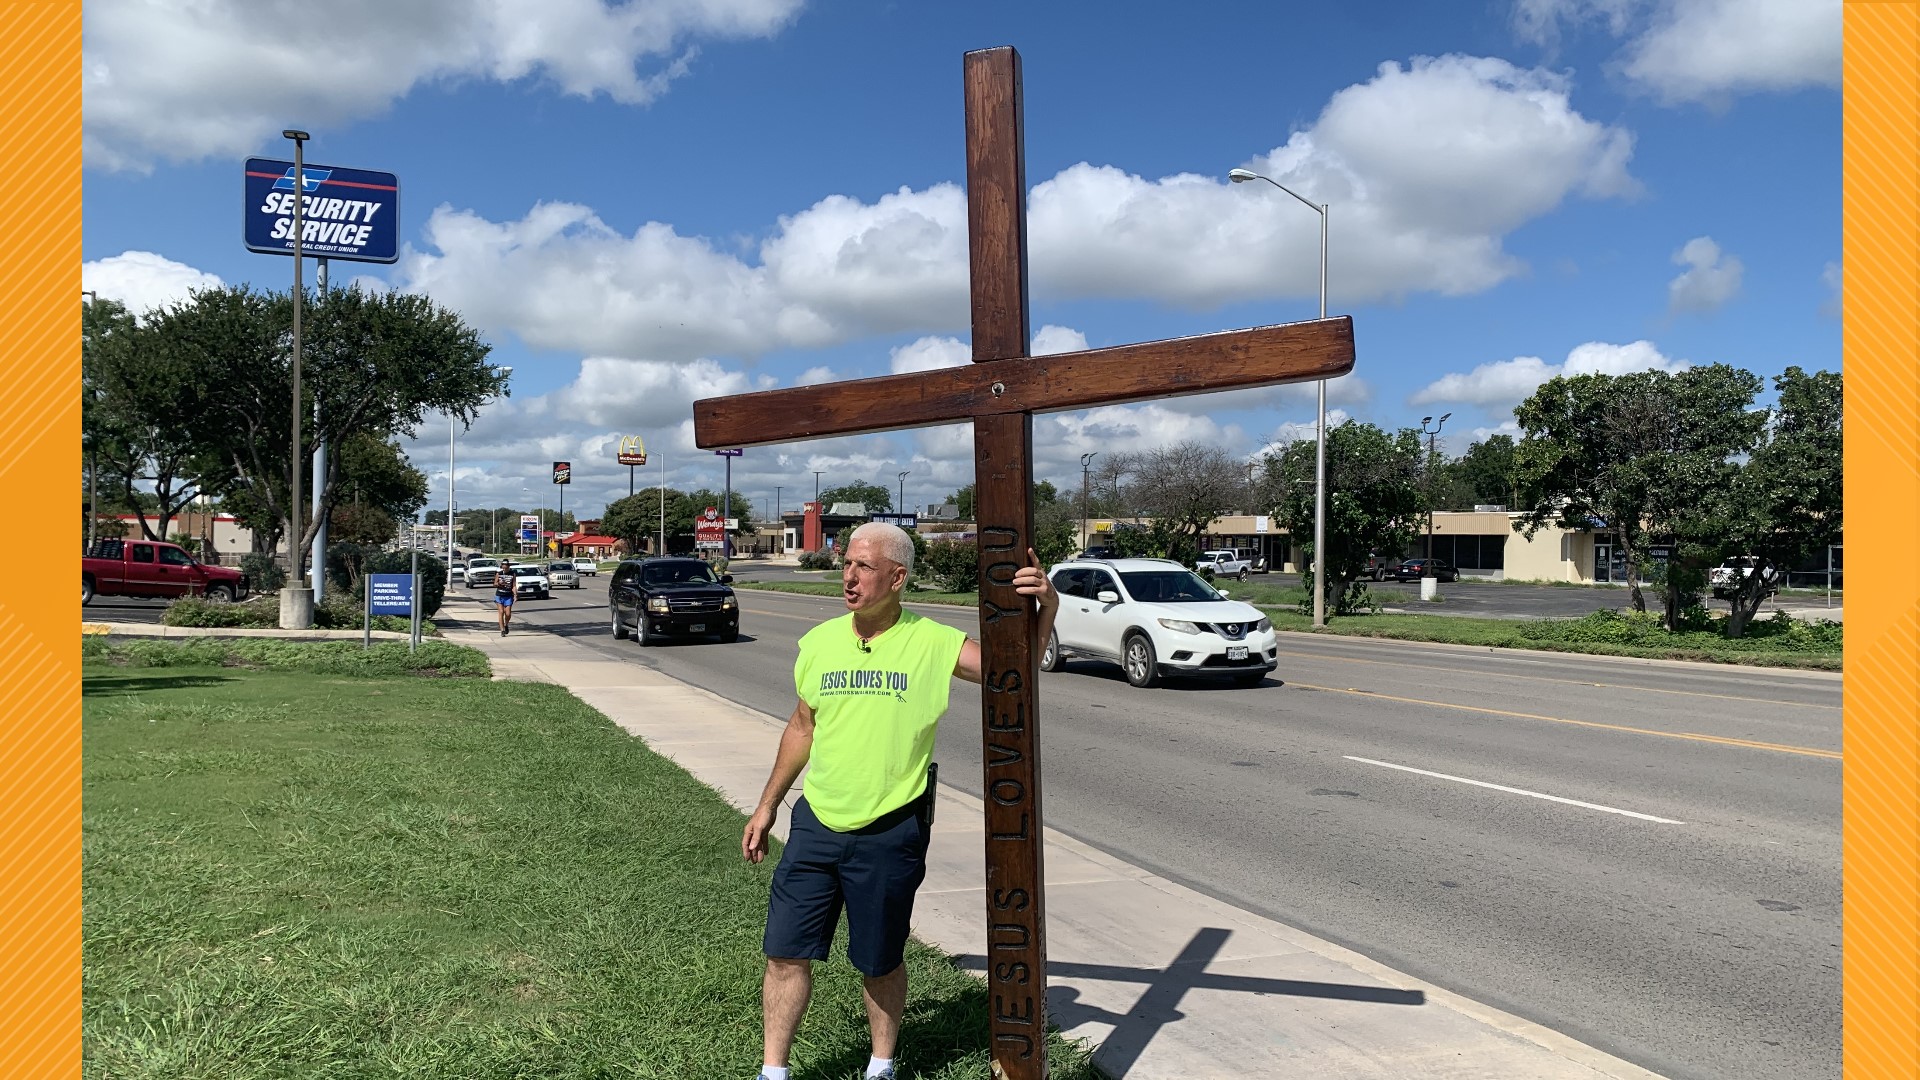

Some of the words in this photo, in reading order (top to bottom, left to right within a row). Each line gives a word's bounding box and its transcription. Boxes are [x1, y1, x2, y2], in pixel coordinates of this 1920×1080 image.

[261, 192, 381, 222] SECURITY
[270, 217, 373, 246] SERVICE
[285, 241, 314, 250] FERAL
[697, 519, 724, 530] Wendy's
[983, 526, 1023, 624] YOU
[820, 670, 848, 691] JESUS
[850, 669, 883, 689] LOVES
[886, 671, 908, 691] YOU
[986, 669, 1029, 841] LOVES
[993, 888, 1034, 1060] JESUS
